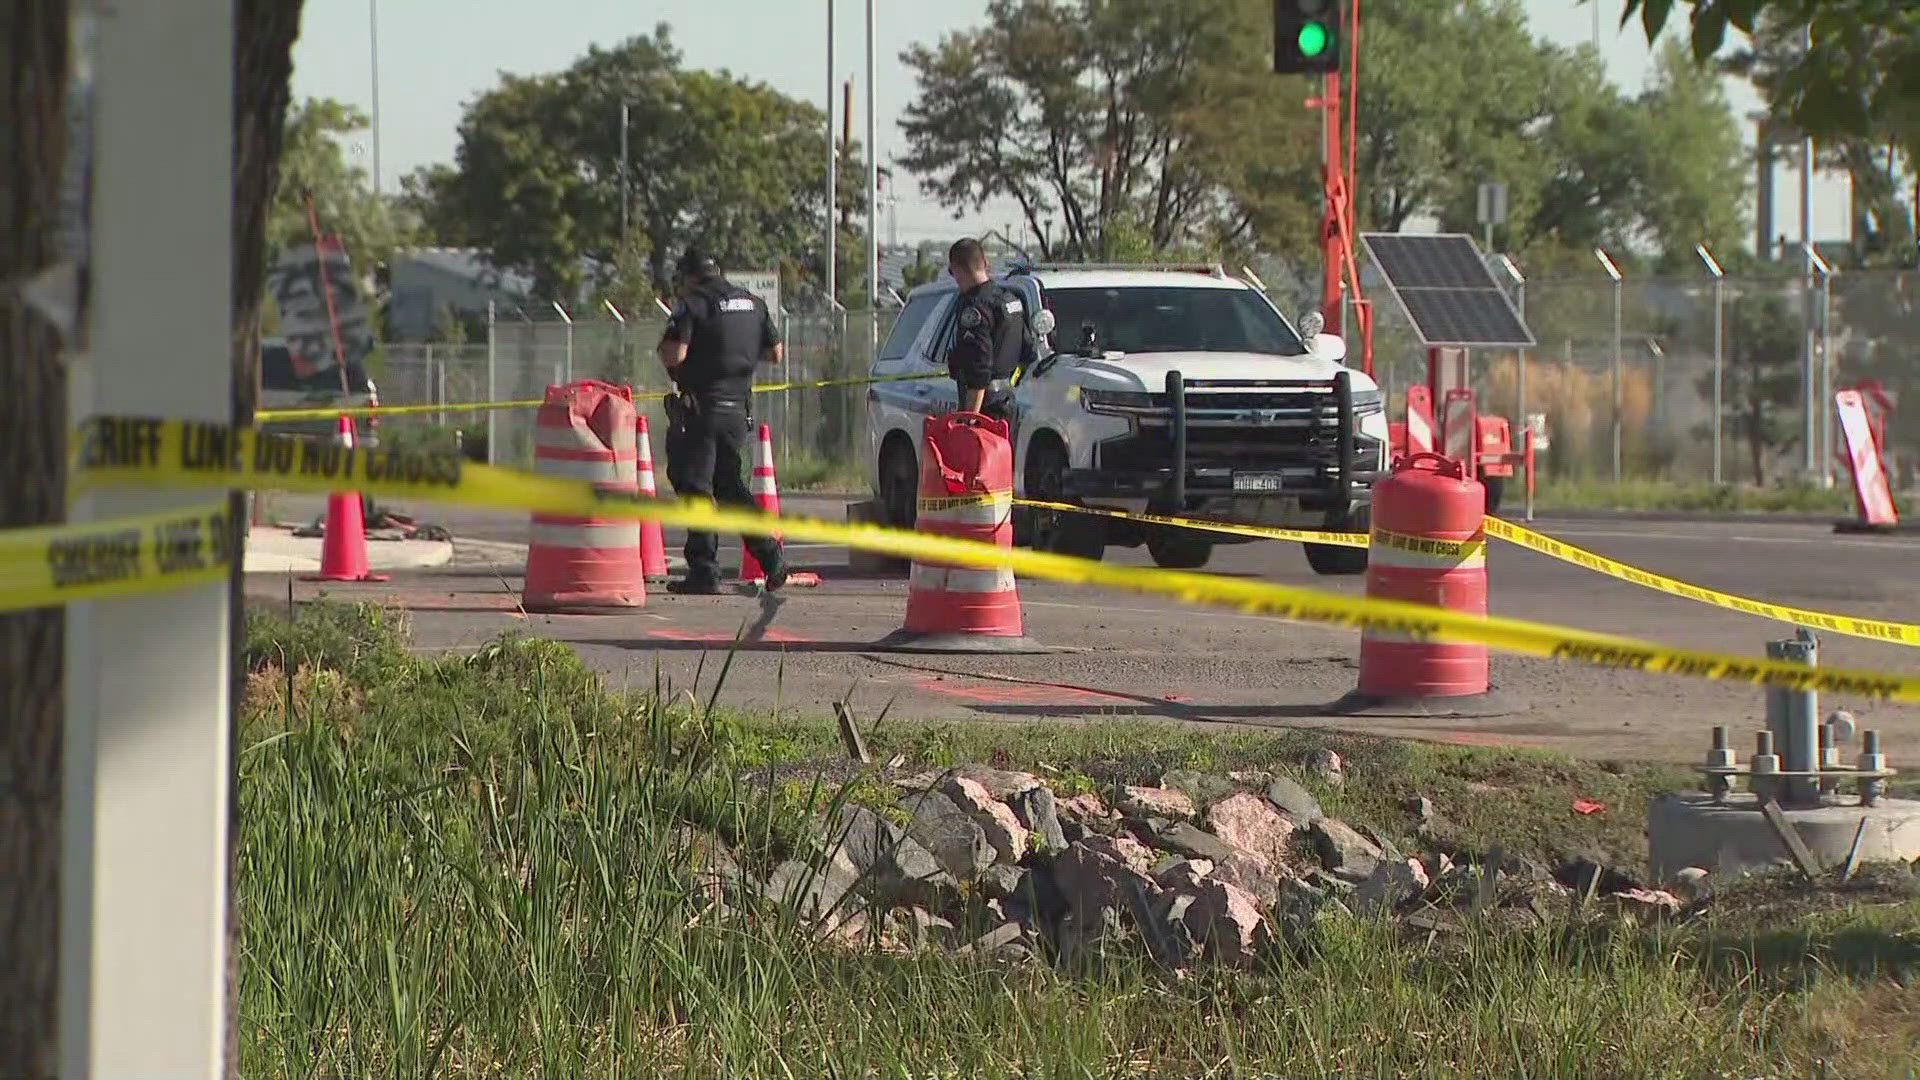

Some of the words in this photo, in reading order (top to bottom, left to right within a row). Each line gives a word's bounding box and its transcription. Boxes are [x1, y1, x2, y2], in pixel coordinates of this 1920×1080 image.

[181, 420, 243, 472] LINE
[254, 432, 293, 475] DO
[300, 440, 356, 480] NOT
[364, 443, 462, 488] CROSS
[154, 518, 205, 574] LINE
[1436, 541, 1460, 556] CROSS
